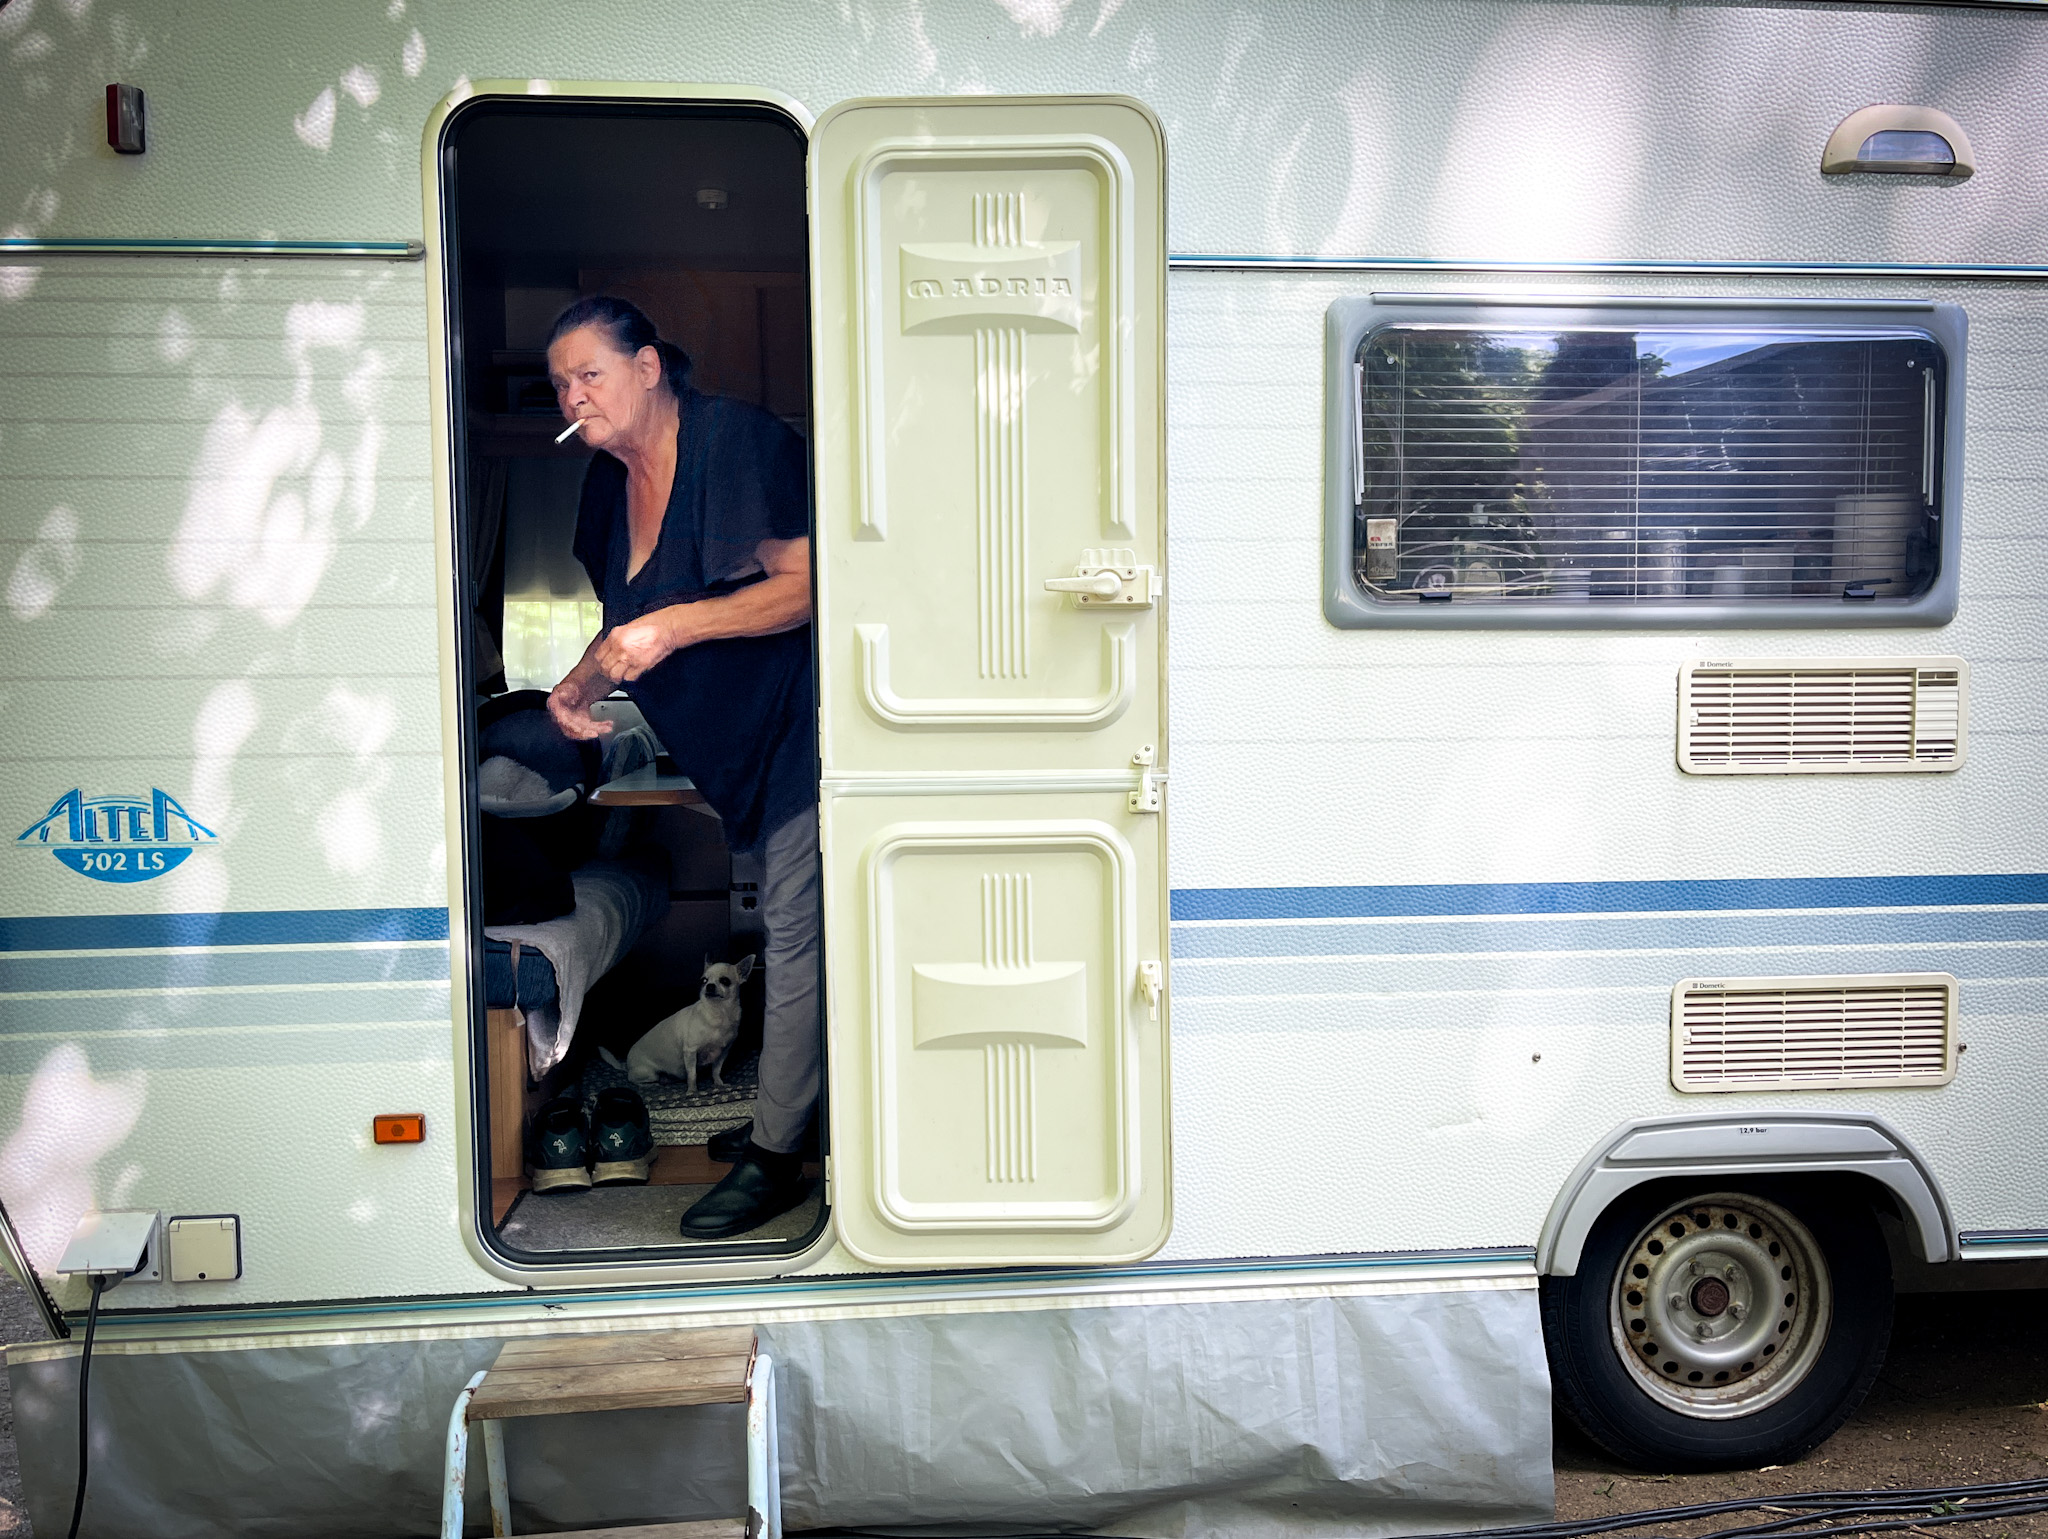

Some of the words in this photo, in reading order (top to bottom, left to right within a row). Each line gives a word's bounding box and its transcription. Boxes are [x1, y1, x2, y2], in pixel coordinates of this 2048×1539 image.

[951, 278, 1072, 297] ADRIA
[16, 787, 218, 842] ALTEA
[82, 852, 127, 871] 502
[138, 851, 165, 870] LS
